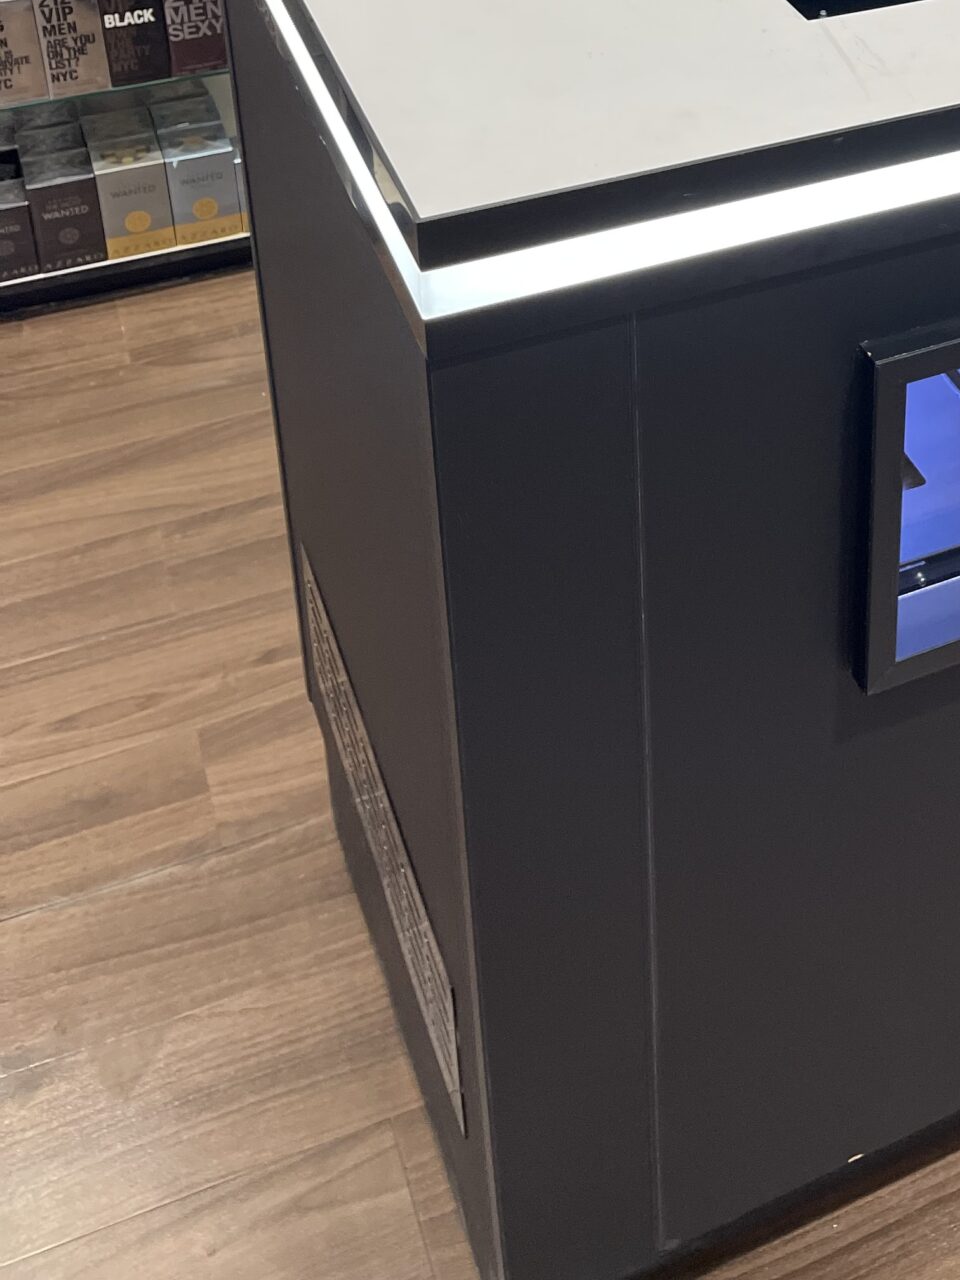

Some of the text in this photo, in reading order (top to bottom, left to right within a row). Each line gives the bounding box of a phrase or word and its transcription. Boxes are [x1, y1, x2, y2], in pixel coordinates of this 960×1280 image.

[41, 6, 74, 24] VIP
[104, 7, 156, 29] BLACK
[165, 0, 222, 25] MEN
[42, 21, 77, 37] MEN
[168, 19, 224, 42] SEXY
[47, 33, 96, 49] ARE YOU
[47, 45, 88, 60] ON THE
[50, 70, 79, 83] NYC
[41, 205, 89, 220] WANTED
